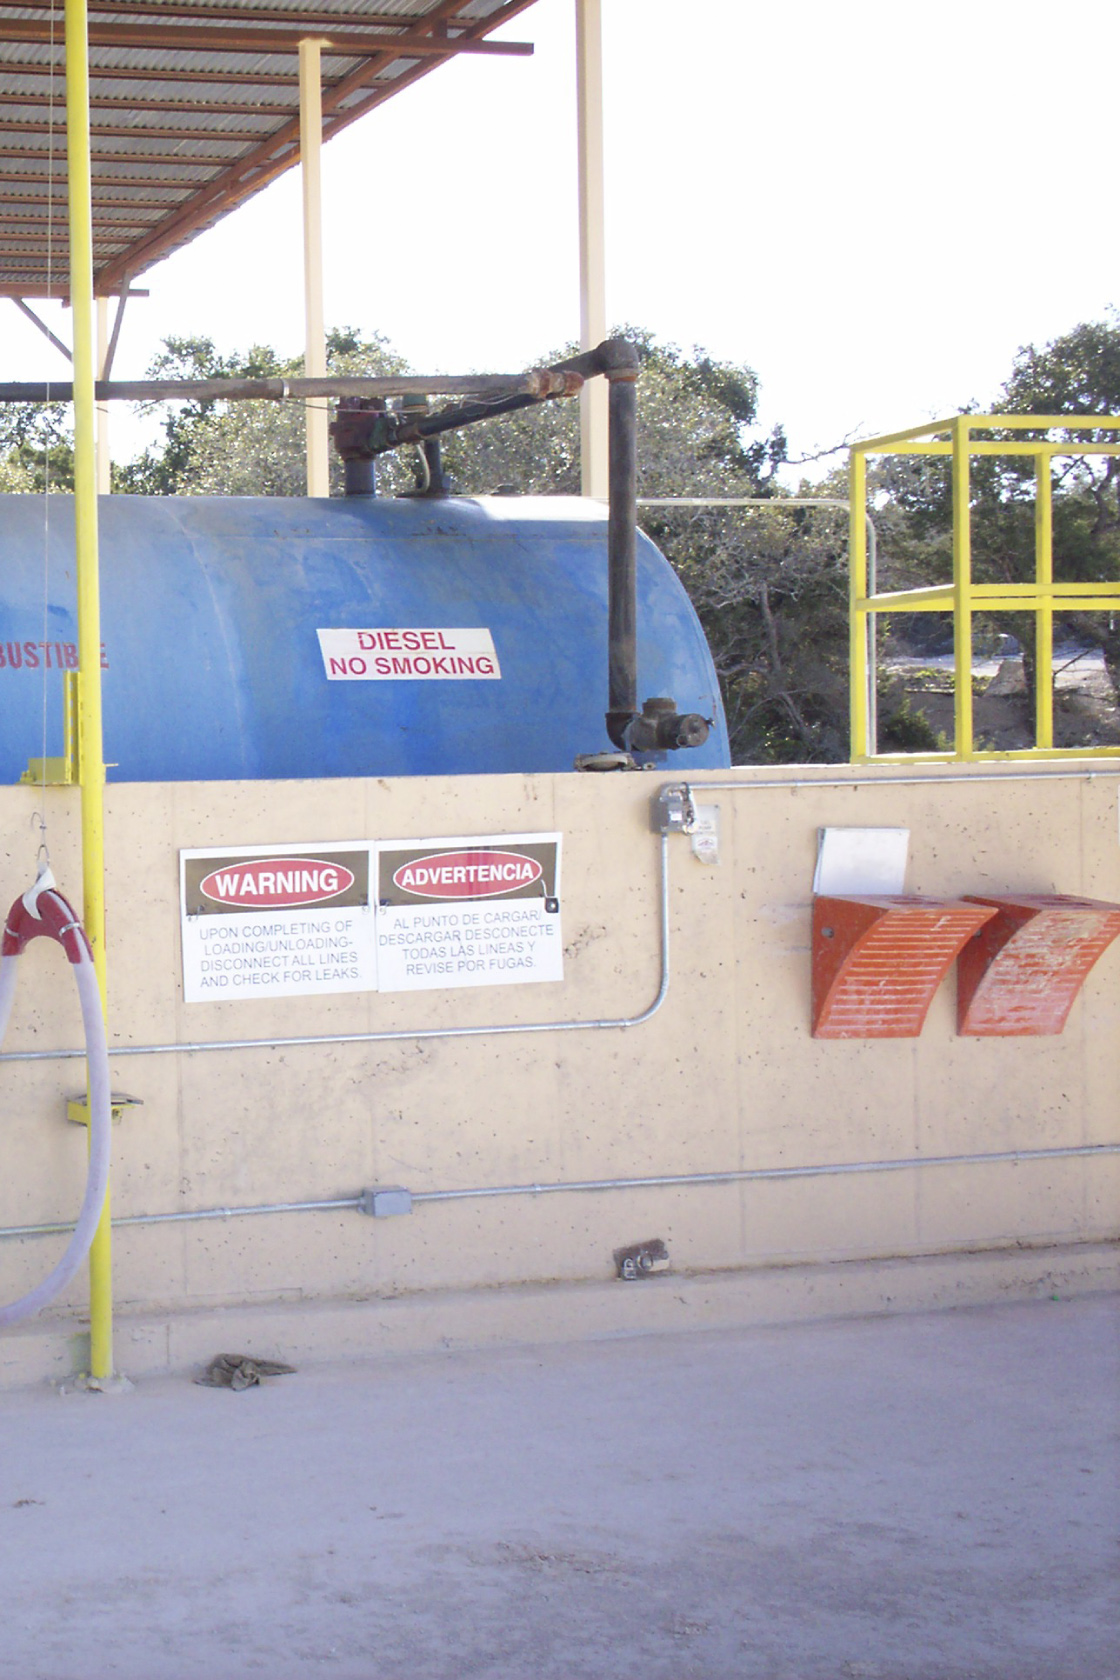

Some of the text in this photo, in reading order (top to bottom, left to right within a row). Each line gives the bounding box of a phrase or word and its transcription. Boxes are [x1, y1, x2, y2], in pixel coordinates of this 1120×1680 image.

[357, 632, 456, 650] DIESEL
[330, 656, 494, 675] NO SMOKING
[215, 868, 338, 897] WARNING
[402, 863, 533, 886] ADVERTENCIA
[394, 909, 542, 929] AL PUNTO DE CARGAR/
[200, 920, 353, 940] UPON COMPLETING OF
[379, 924, 554, 946] DESCARGAR DESCONECTE
[204, 936, 353, 956] LOADING/UNLOADING-
[402, 941, 535, 960] TODAS LAS LINEAS Y
[200, 951, 358, 972] DISCONNECT ALL LINES
[406, 956, 536, 975] REVISE POR FUGAS.
[200, 967, 361, 987] AND CHECK FOR LEAKS.
